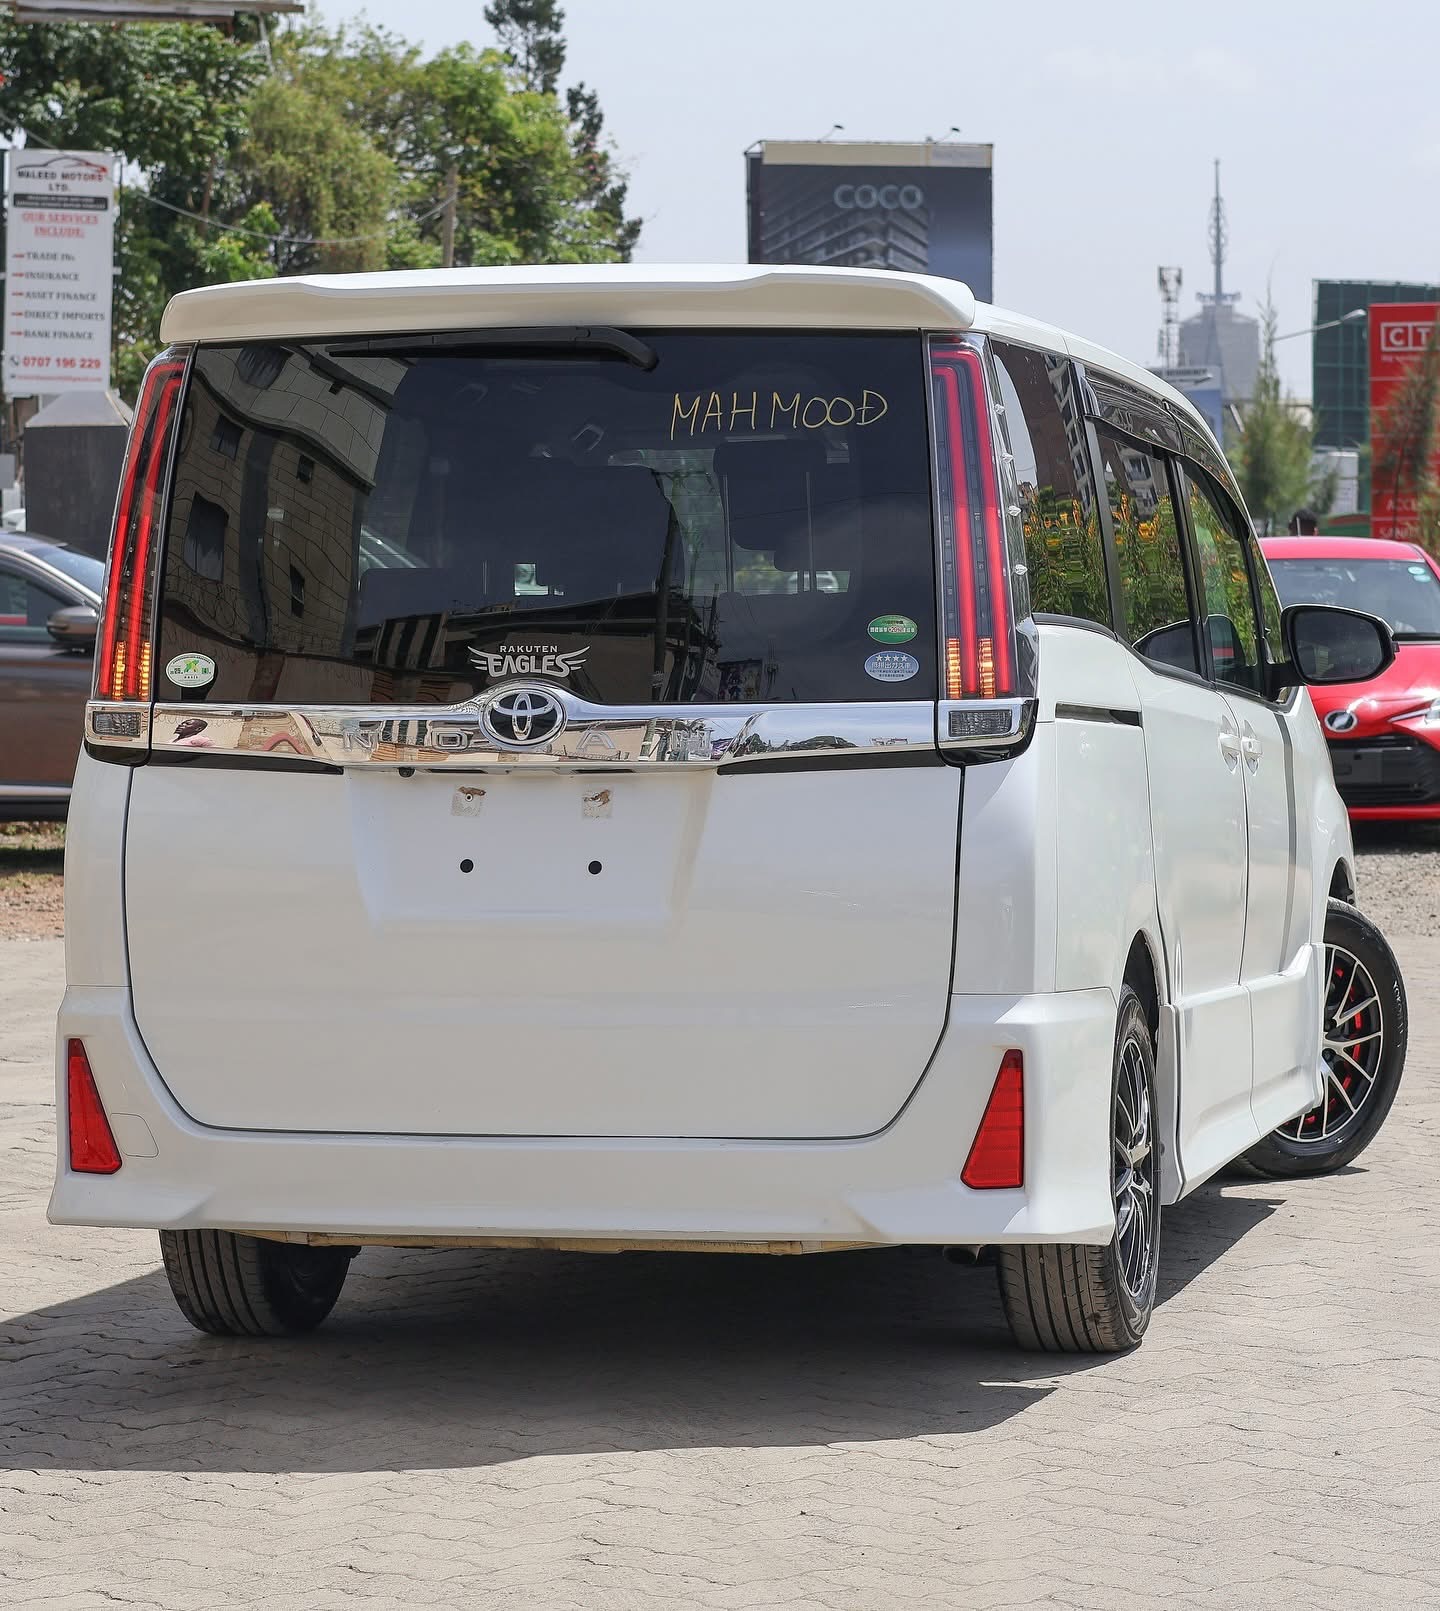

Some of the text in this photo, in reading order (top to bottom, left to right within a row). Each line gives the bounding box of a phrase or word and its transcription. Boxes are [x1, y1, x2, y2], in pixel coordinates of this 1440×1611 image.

[17, 171, 104, 182] WALEED MOTORS
[833, 184, 924, 209] COCO
[22, 212, 98, 225] OUR SERVICES
[26, 252, 58, 261] TRADE
[24, 271, 80, 281] INSURANCE
[25, 291, 97, 302] ASSET FINANCE
[24, 311, 105, 321] DIRECT IMPORTS
[23, 330, 94, 340] BANK FINANCE
[22, 356, 101, 369] 0707 196 229
[499, 645, 558, 653] RAKUTEN
[484, 654, 571, 678] EAGLES
